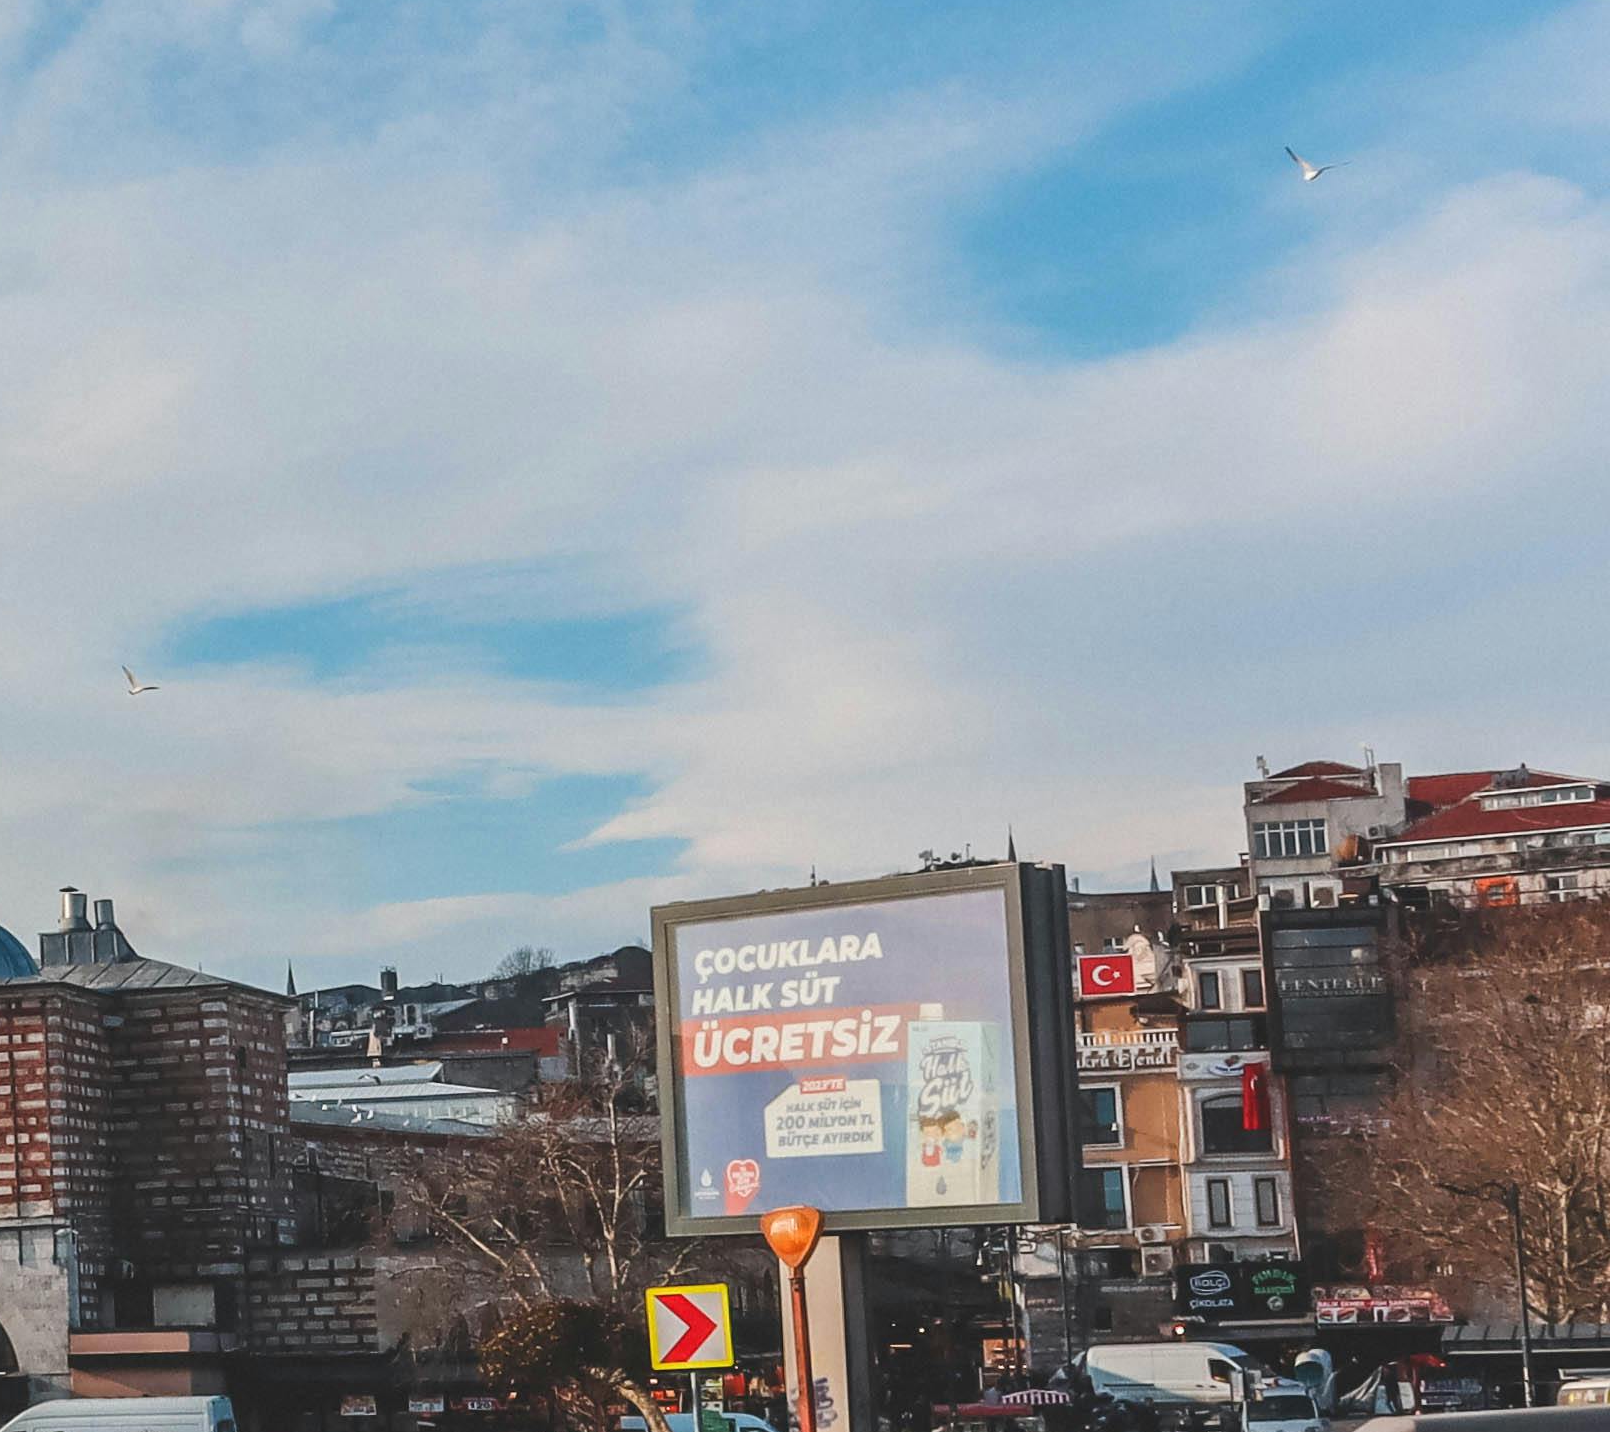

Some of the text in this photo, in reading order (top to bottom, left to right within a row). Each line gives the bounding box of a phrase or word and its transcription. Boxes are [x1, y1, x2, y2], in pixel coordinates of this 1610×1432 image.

[695, 932, 883, 981] ÇOCUKLARA
[691, 971, 840, 1016] HALK SÜT
[776, 1115, 805, 1130] 200
[860, 1114, 875, 1125] TL
[778, 1131, 874, 1148] BÜTÇE AYIRDIK
